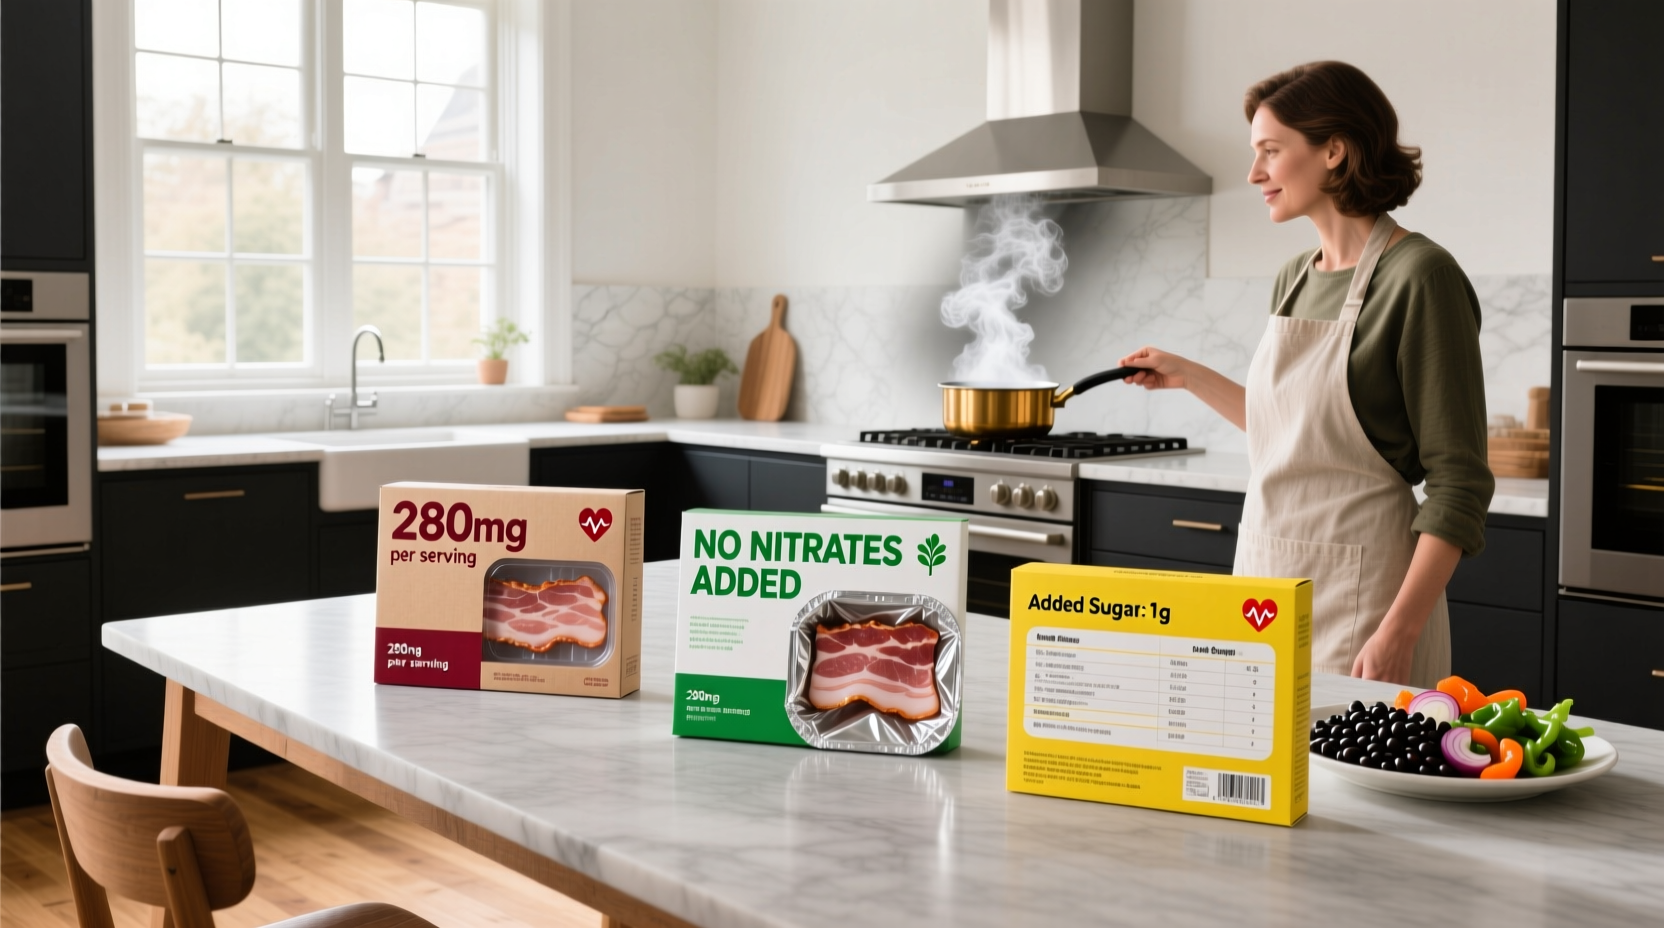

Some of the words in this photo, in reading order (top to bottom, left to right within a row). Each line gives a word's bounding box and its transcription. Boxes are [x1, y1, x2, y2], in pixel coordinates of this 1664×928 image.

[391, 500, 527, 553] 280mg
[390, 549, 416, 566] per
[420, 548, 477, 568] serving
[694, 529, 741, 560] NO
[750, 530, 903, 567] NITRATES
[690, 564, 802, 600] ADDED
[1028, 593, 1084, 613] Added
[1089, 597, 1146, 621] Sugar:
[1150, 602, 1171, 624] 1g
